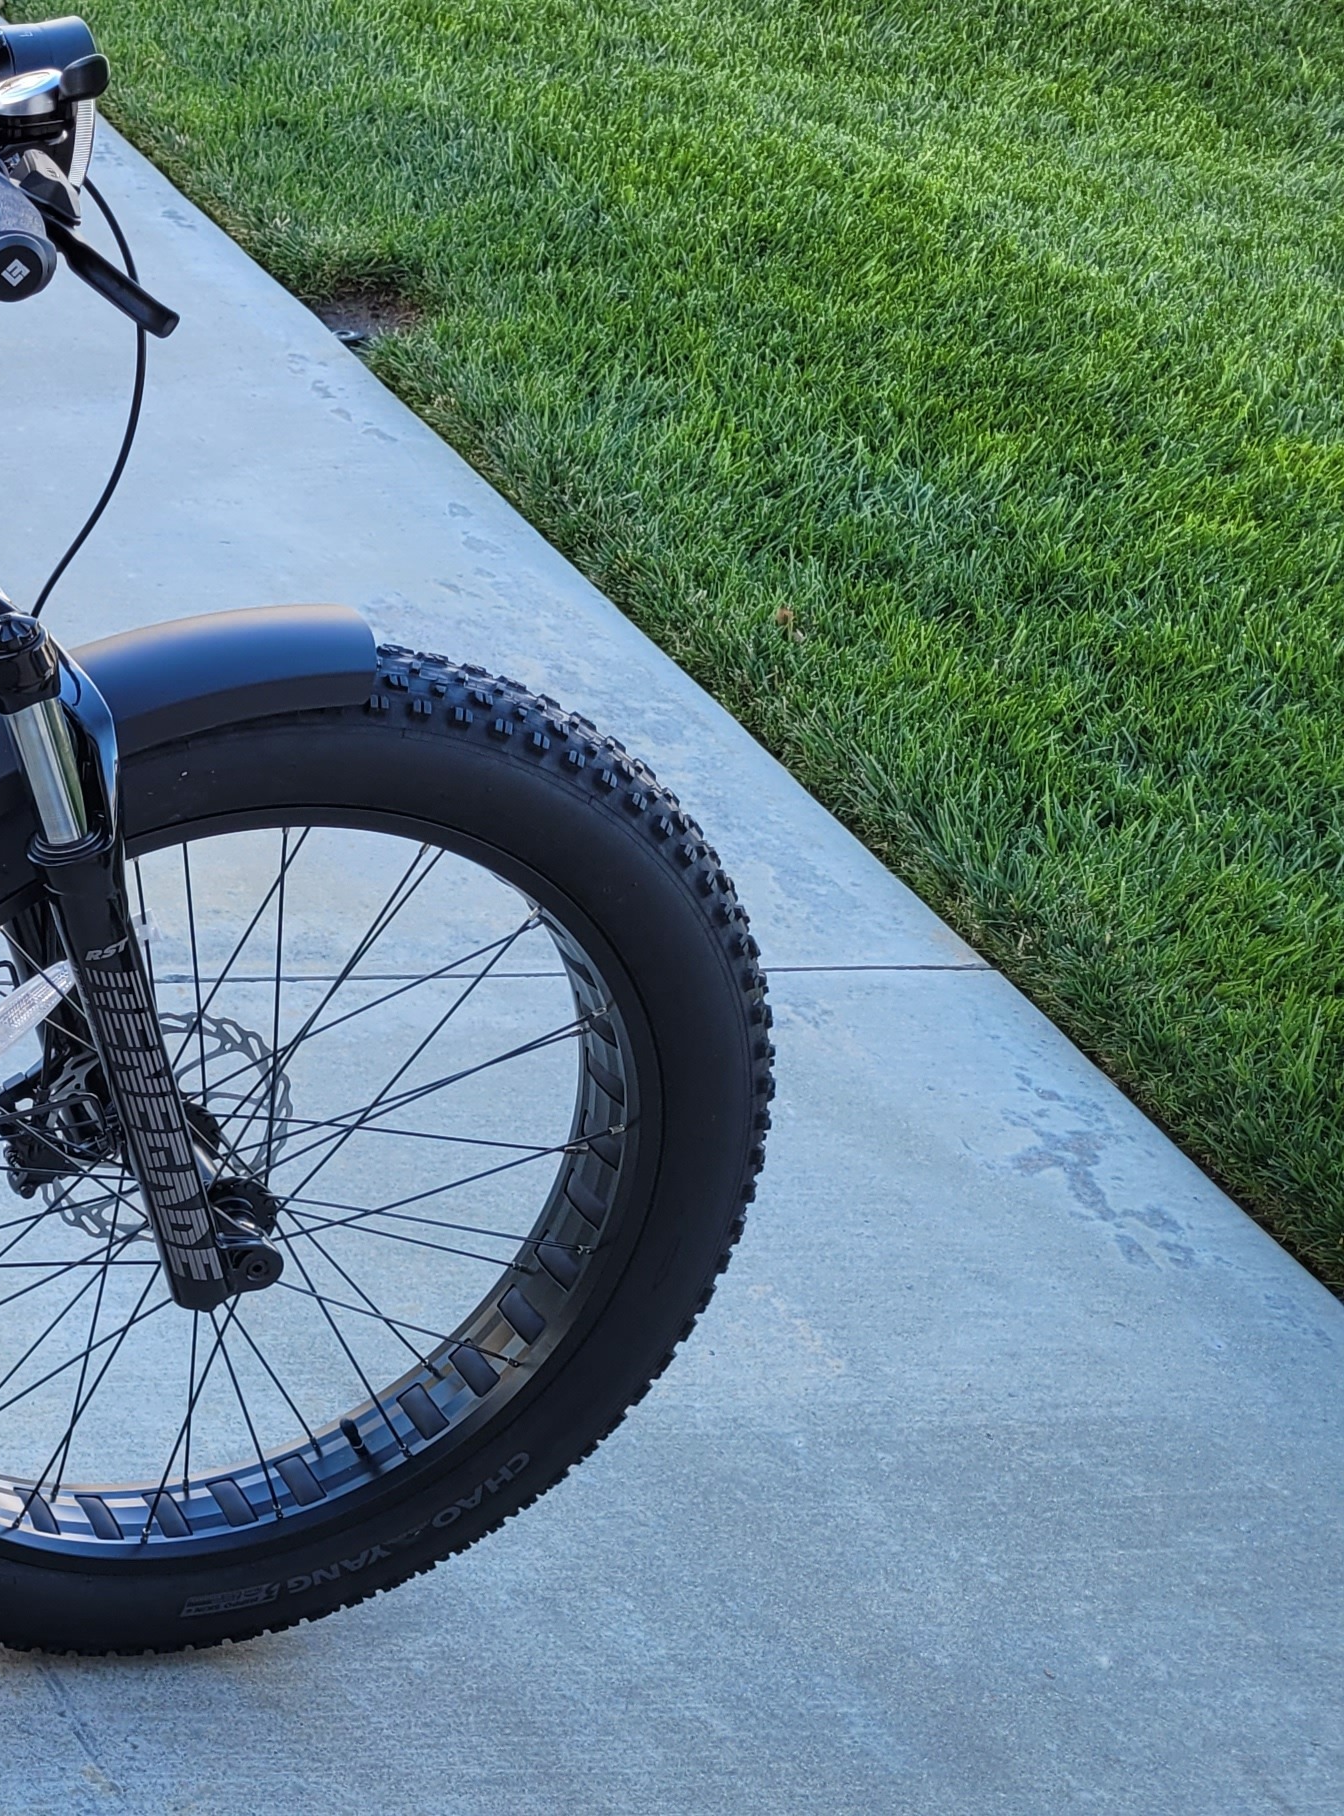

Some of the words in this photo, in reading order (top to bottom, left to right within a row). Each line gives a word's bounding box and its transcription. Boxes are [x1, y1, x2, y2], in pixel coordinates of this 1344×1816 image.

[85, 936, 129, 961] RST
[85, 967, 223, 1281] RENEGADE
[431, 1452, 530, 1528] CHAO
[287, 1544, 391, 1594] YANG
